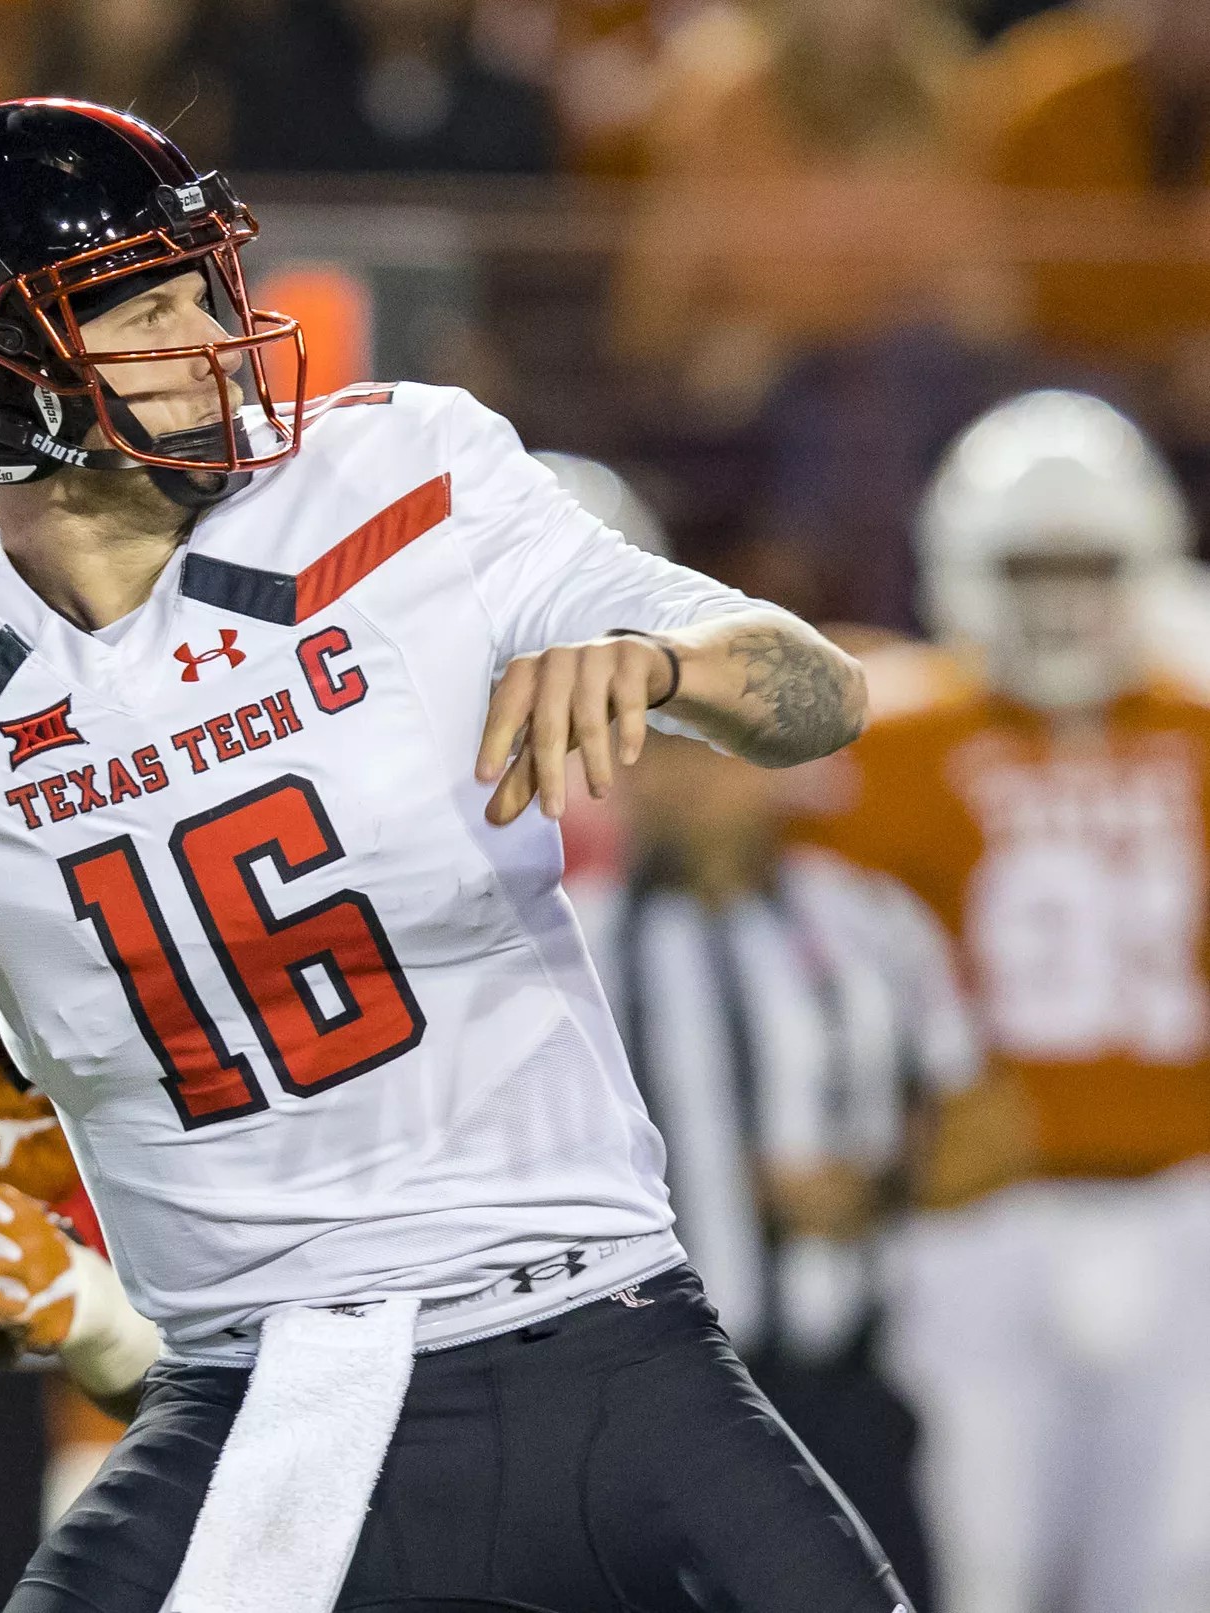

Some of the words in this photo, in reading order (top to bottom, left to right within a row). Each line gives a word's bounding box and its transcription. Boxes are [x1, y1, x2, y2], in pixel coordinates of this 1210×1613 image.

[31, 433, 89, 468] chutt
[41, 387, 59, 424] schut
[296, 625, 369, 715] C
[5, 745, 169, 830] TEXAS
[172, 688, 304, 775] TECH
[57, 773, 428, 1132] 16
